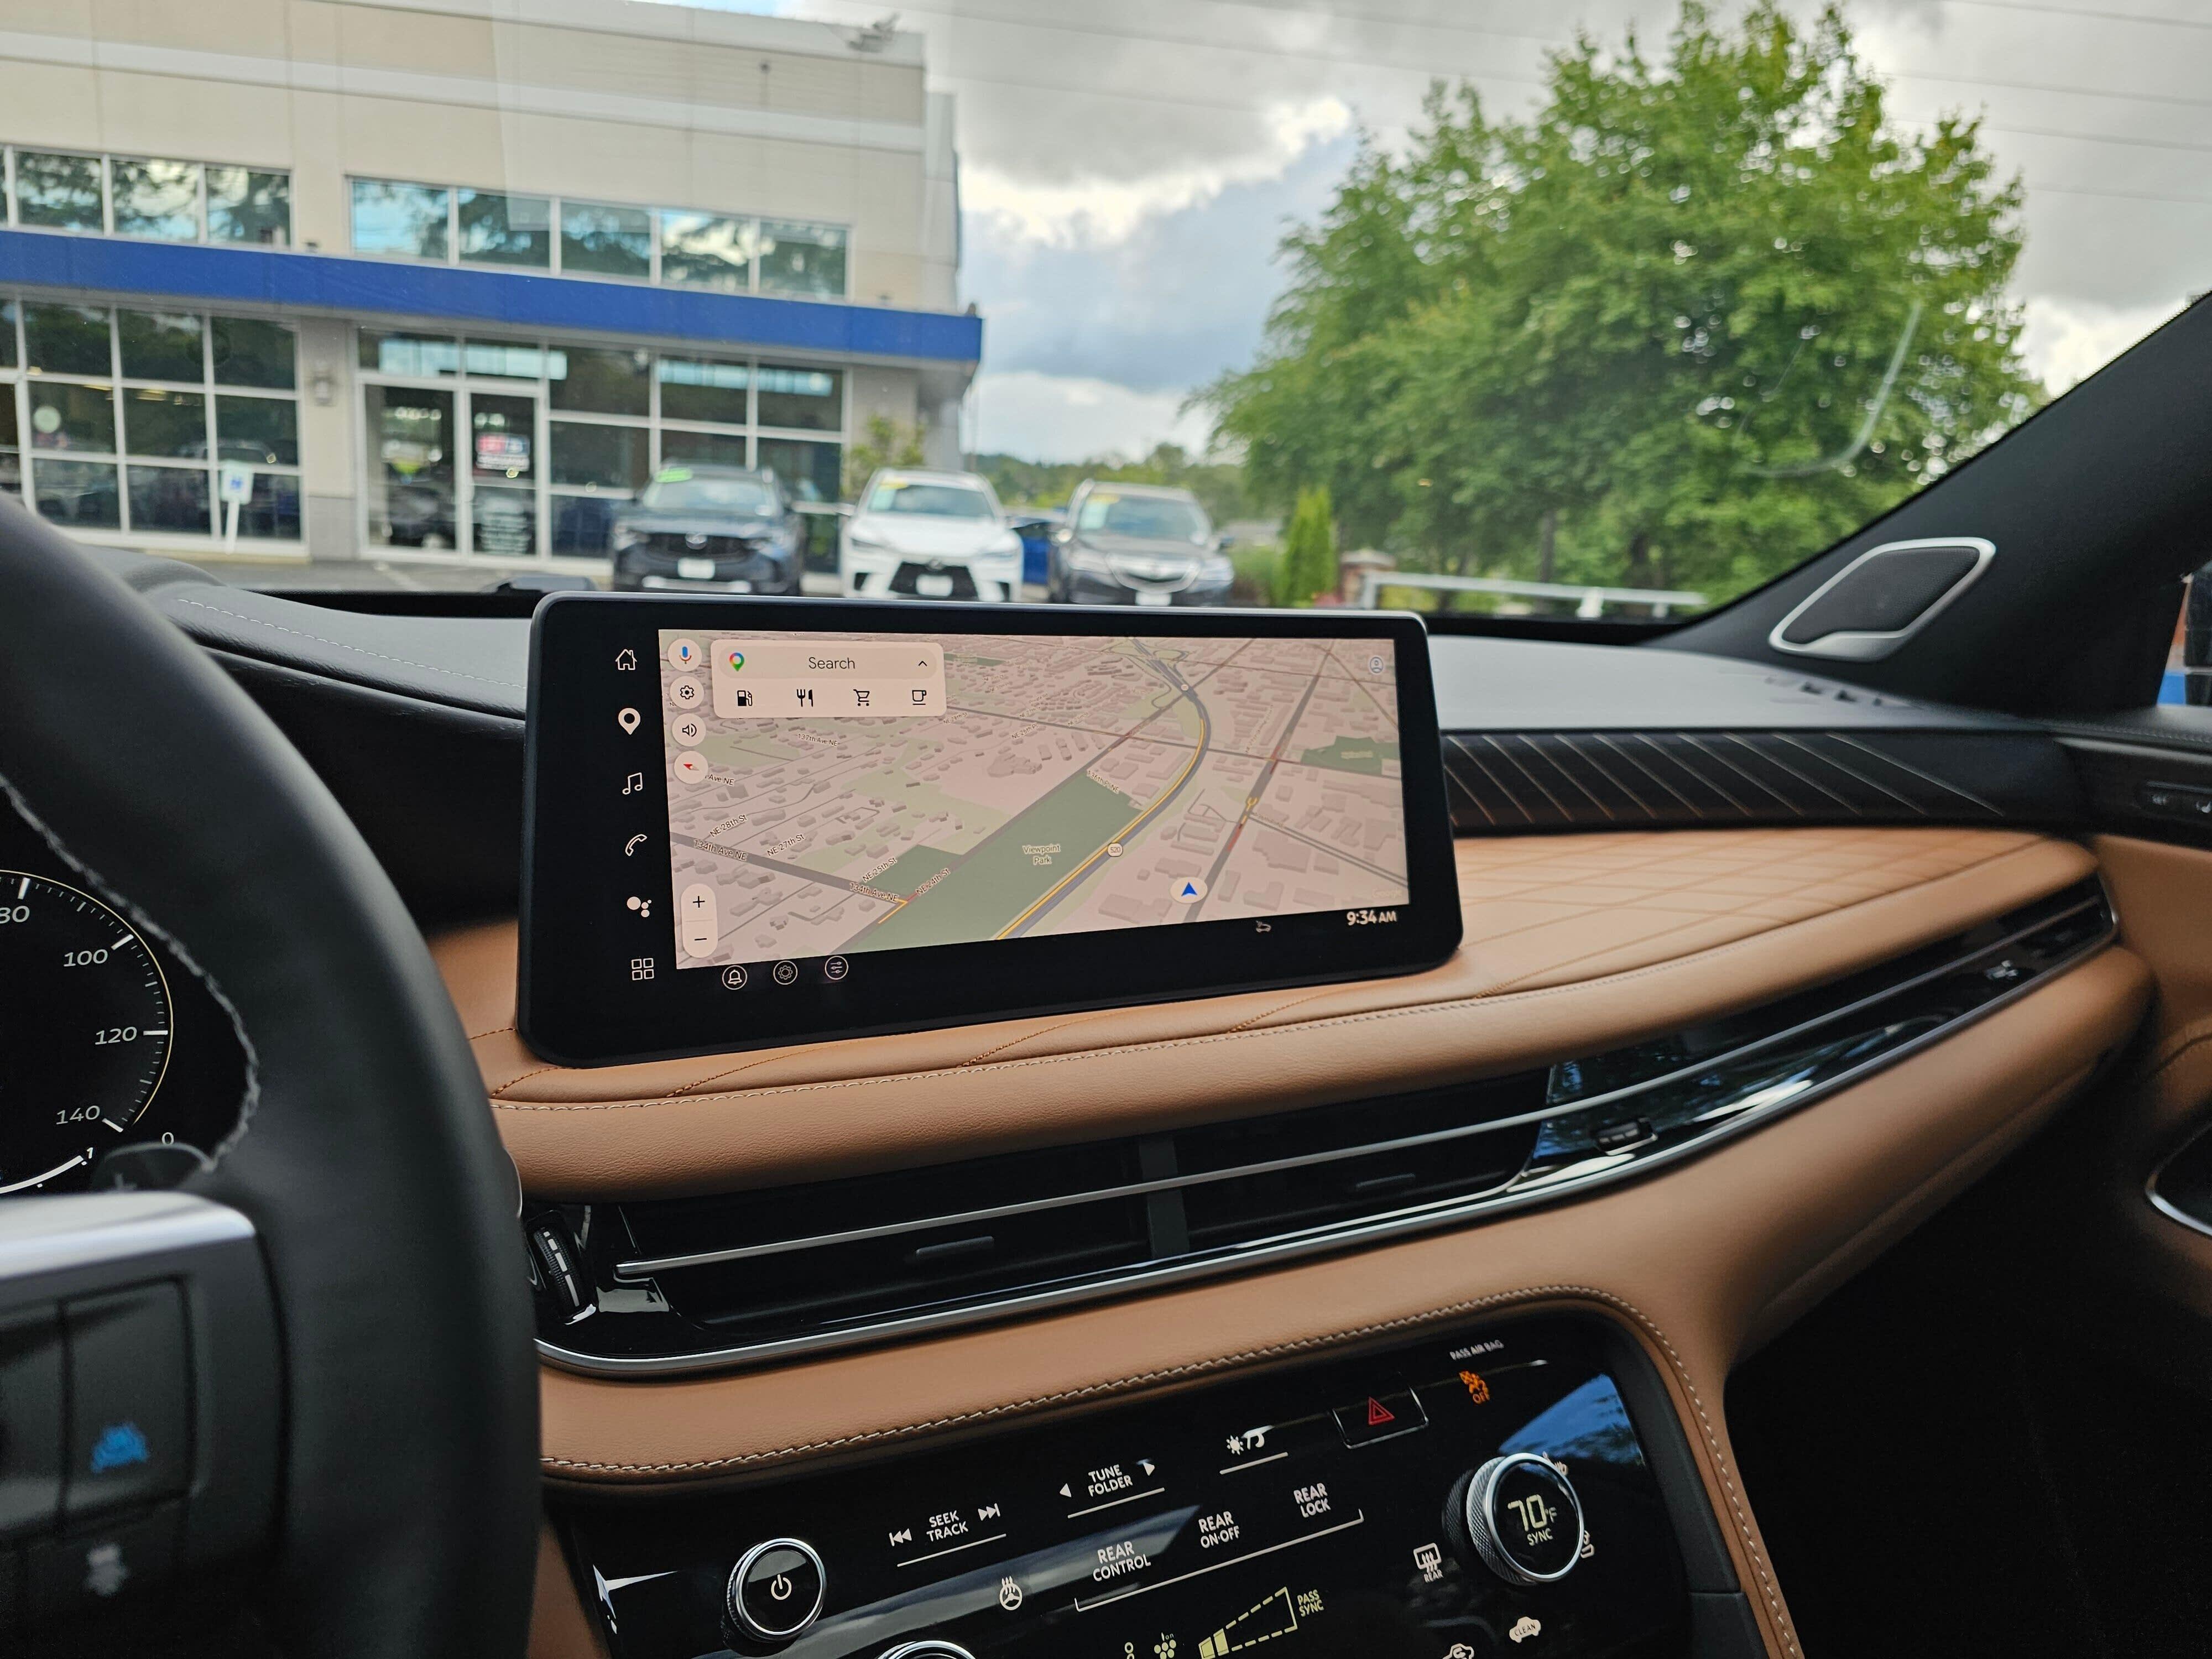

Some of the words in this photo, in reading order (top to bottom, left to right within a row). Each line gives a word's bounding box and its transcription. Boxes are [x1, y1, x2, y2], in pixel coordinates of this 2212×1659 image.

[808, 656, 856, 670] Search
[798, 733, 816, 742] 137th
[709, 774, 722, 782] Ave
[723, 777, 734, 785] NE
[1112, 784, 1119, 792] NE
[709, 827, 721, 837] NE
[721, 817, 739, 831] 28th
[738, 814, 747, 822] St
[694, 839, 716, 852] 134th
[717, 847, 733, 857] Ave
[735, 852, 747, 860] NE
[767, 847, 778, 856] NE
[778, 838, 796, 851] 27th
[795, 833, 805, 842] St
[1024, 844, 1060, 854] Viewpoint
[862, 872, 873, 881] NE
[873, 862, 889, 877] 25th
[888, 858, 897, 866] St
[916, 885, 927, 894] NE
[926, 874, 942, 889] 24th
[941, 868, 950, 877] St
[849, 883, 870, 894] 134th
[872, 890, 885, 899] Ave
[886, 893, 898, 901] NE
[1346, 910, 1377, 926] 9:34
[1379, 911, 1397, 924] AM
[64, 949, 108, 967] 100
[95, 1026, 137, 1045] 120
[56, 1105, 100, 1125] 140
[161, 1132, 174, 1145] 0
[1088, 1464, 1123, 1484] TUNE
[1087, 1475, 1133, 1498] FOLDER
[1293, 1482, 1328, 1505] REAR
[1300, 1498, 1332, 1519] LOCK
[928, 1510, 961, 1528] SEEK
[1198, 1510, 1234, 1533] REAR
[926, 1521, 969, 1542] TRACK
[1527, 1527, 1554, 1547] SYNC
[1097, 1540, 1135, 1564] REAR
[1092, 1553, 1151, 1582] CONTROL
[1423, 1569, 1444, 1583] REAR
[1297, 1589, 1320, 1606] PASS
[1298, 1599, 1324, 1618] SYNC
[1514, 1624, 1536, 1637] CLEAN
